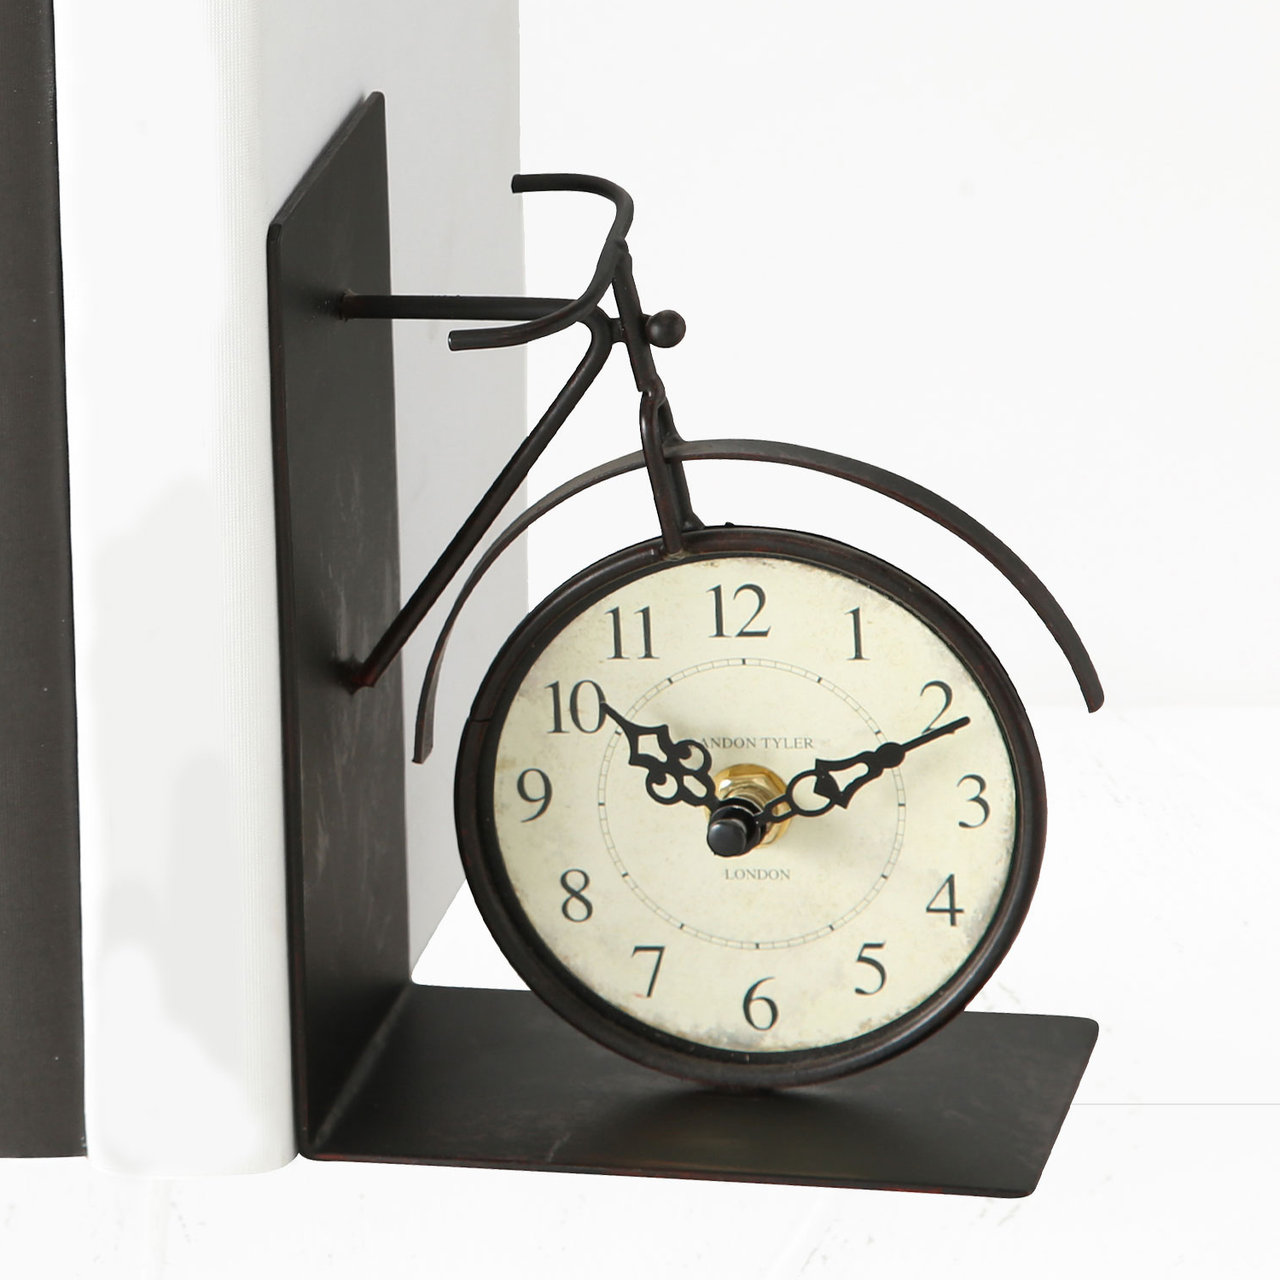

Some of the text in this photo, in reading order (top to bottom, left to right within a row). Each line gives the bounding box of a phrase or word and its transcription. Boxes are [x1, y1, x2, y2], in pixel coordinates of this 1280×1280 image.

[604, 606, 661, 660] 11
[706, 583, 772, 638] 12
[847, 606, 870, 661] 1
[544, 679, 607, 734] 10
[920, 680, 954, 734] 2
[700, 736, 814, 749] ANDON TYLER
[516, 768, 554, 823] 9
[957, 773, 991, 829] 3
[559, 868, 594, 923] 8
[724, 868, 791, 881] LONDON
[925, 873, 965, 927] 4
[631, 945, 666, 998] 7
[854, 942, 888, 996] 5
[742, 977, 779, 1032] 6
